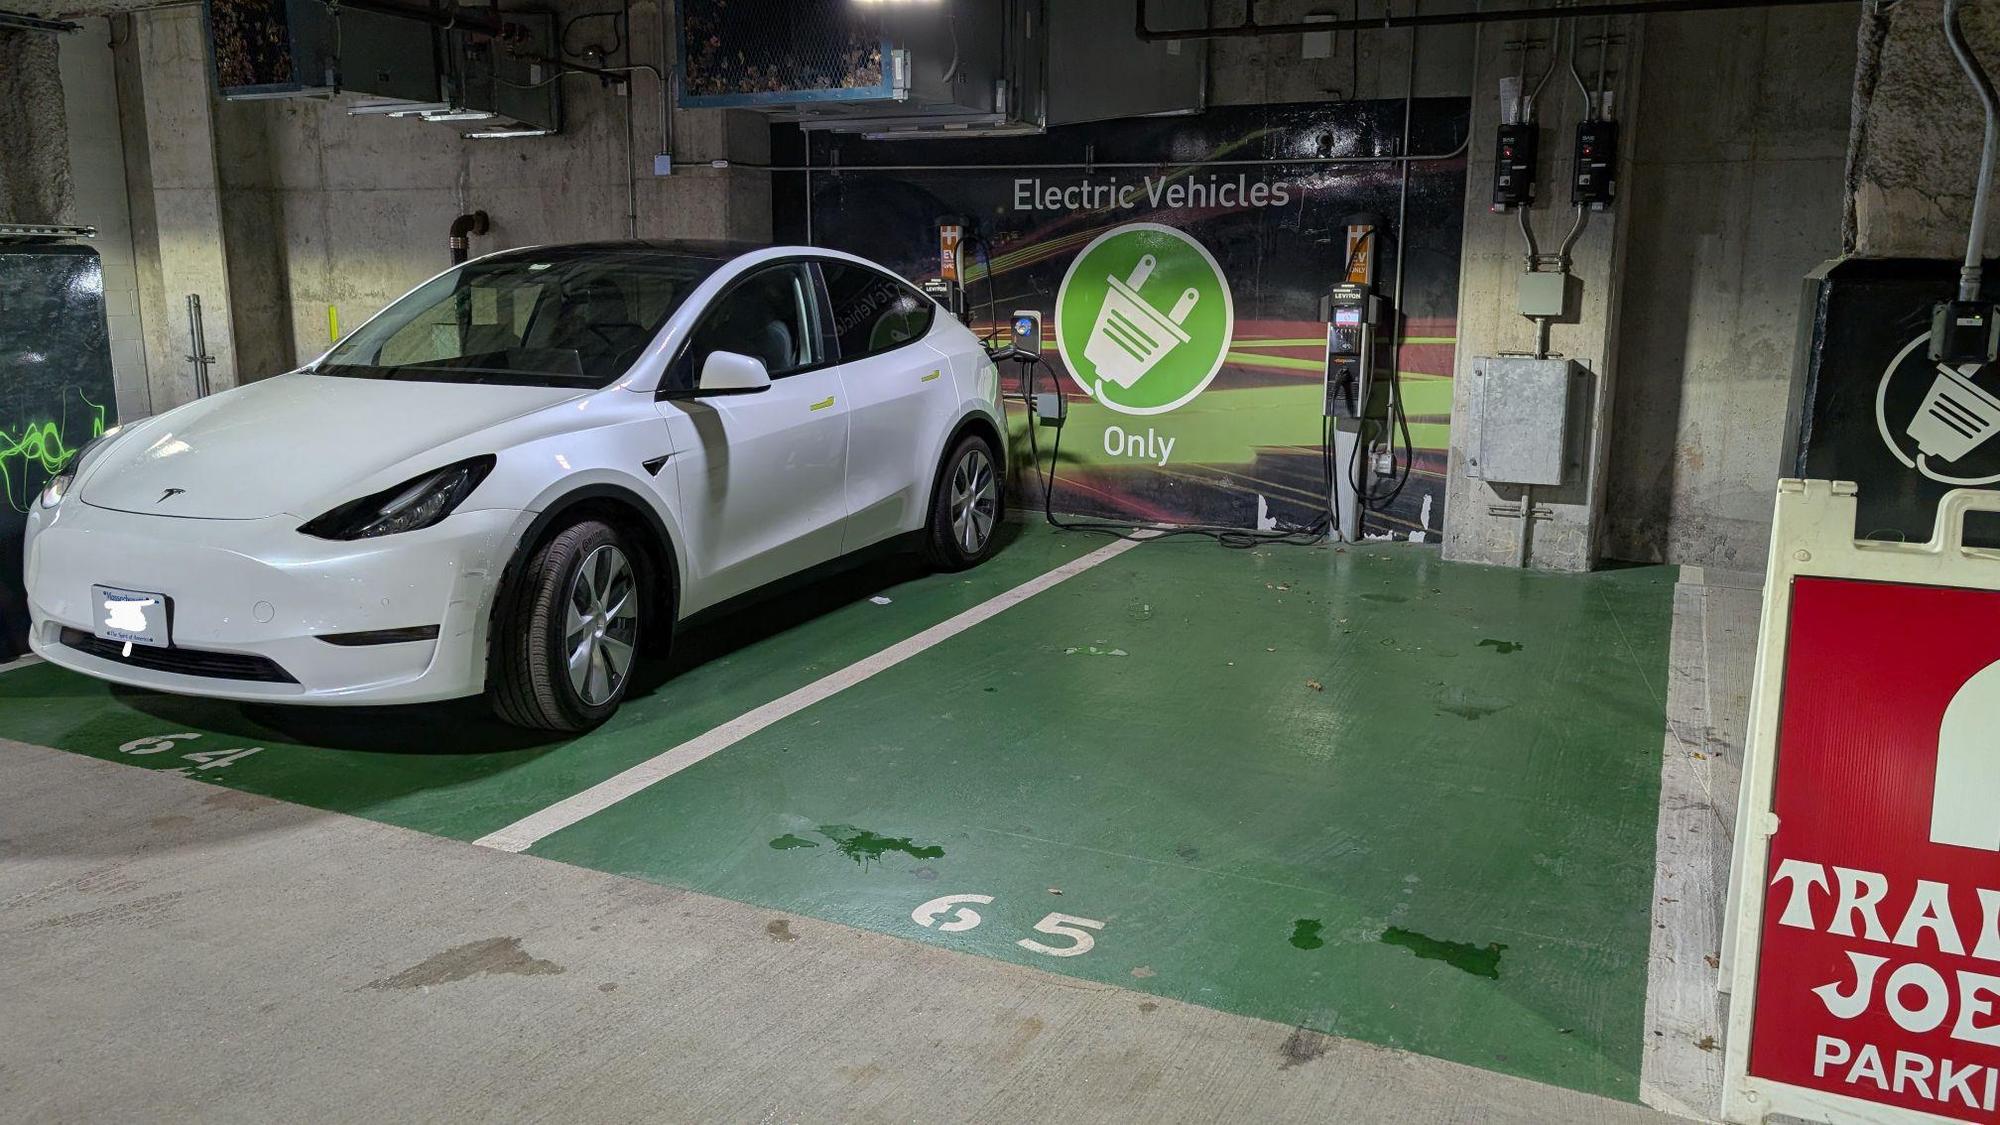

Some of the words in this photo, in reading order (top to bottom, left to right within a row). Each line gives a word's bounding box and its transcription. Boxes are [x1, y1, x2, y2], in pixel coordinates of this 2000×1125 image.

[1014, 177, 1135, 210] Electric
[1144, 174, 1290, 208] Vehicles
[1104, 426, 1176, 467] Only
[119, 733, 265, 770] 64
[911, 894, 1106, 957] 65
[1811, 950, 2000, 1047] JOE
[1814, 1035, 1998, 1112] PARKI
